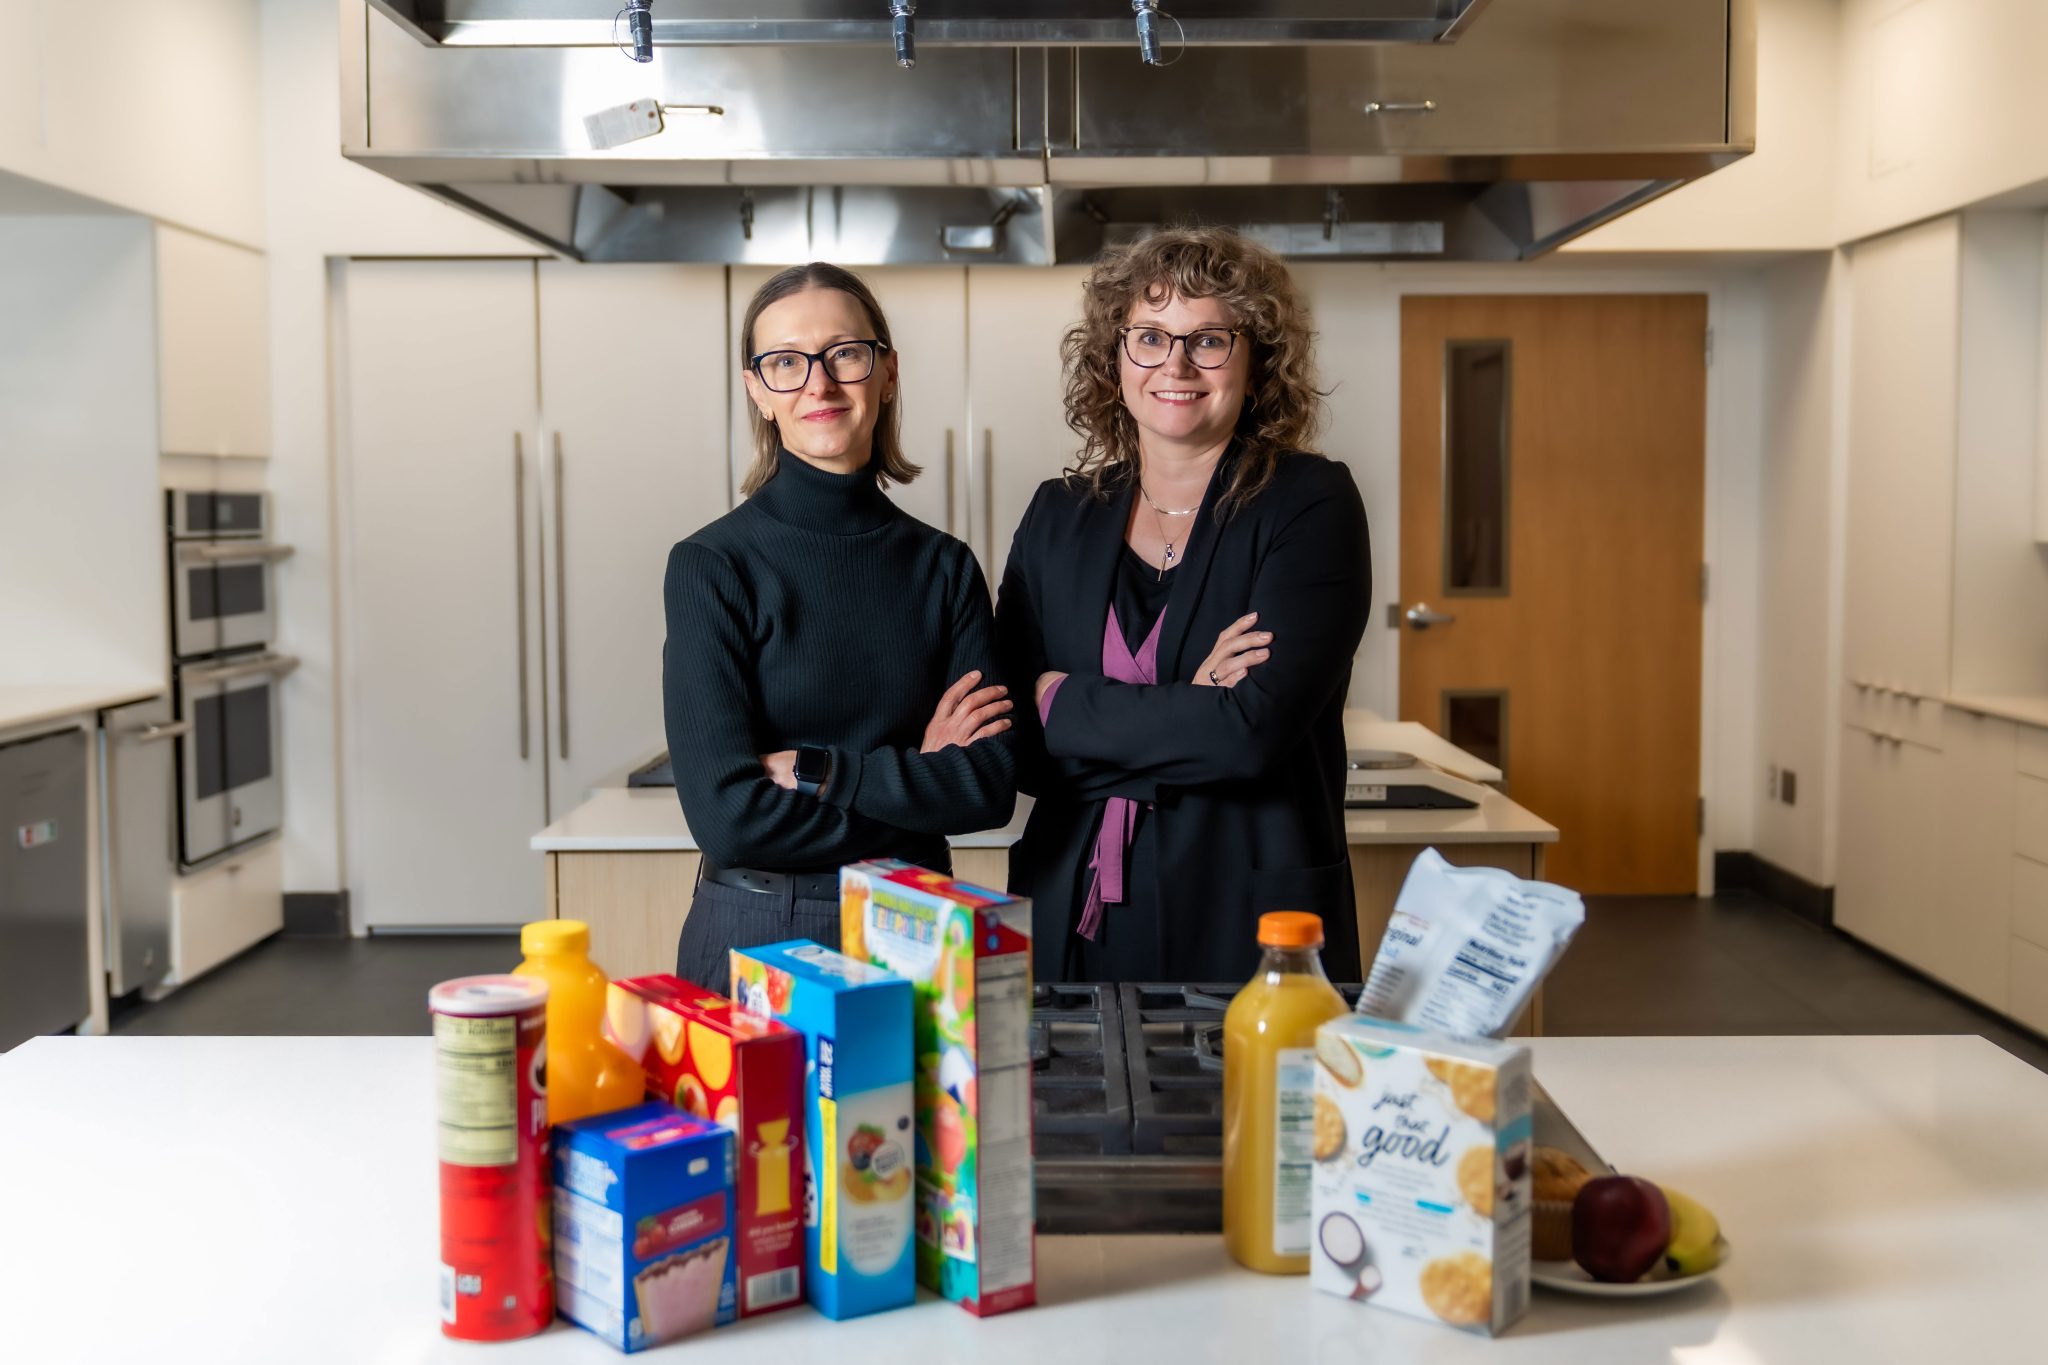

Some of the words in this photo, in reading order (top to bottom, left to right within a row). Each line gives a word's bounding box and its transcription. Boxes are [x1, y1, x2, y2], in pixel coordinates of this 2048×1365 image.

[1373, 1090, 1418, 1111] just
[1395, 1114, 1430, 1132] that
[1357, 1124, 1451, 1168] good
